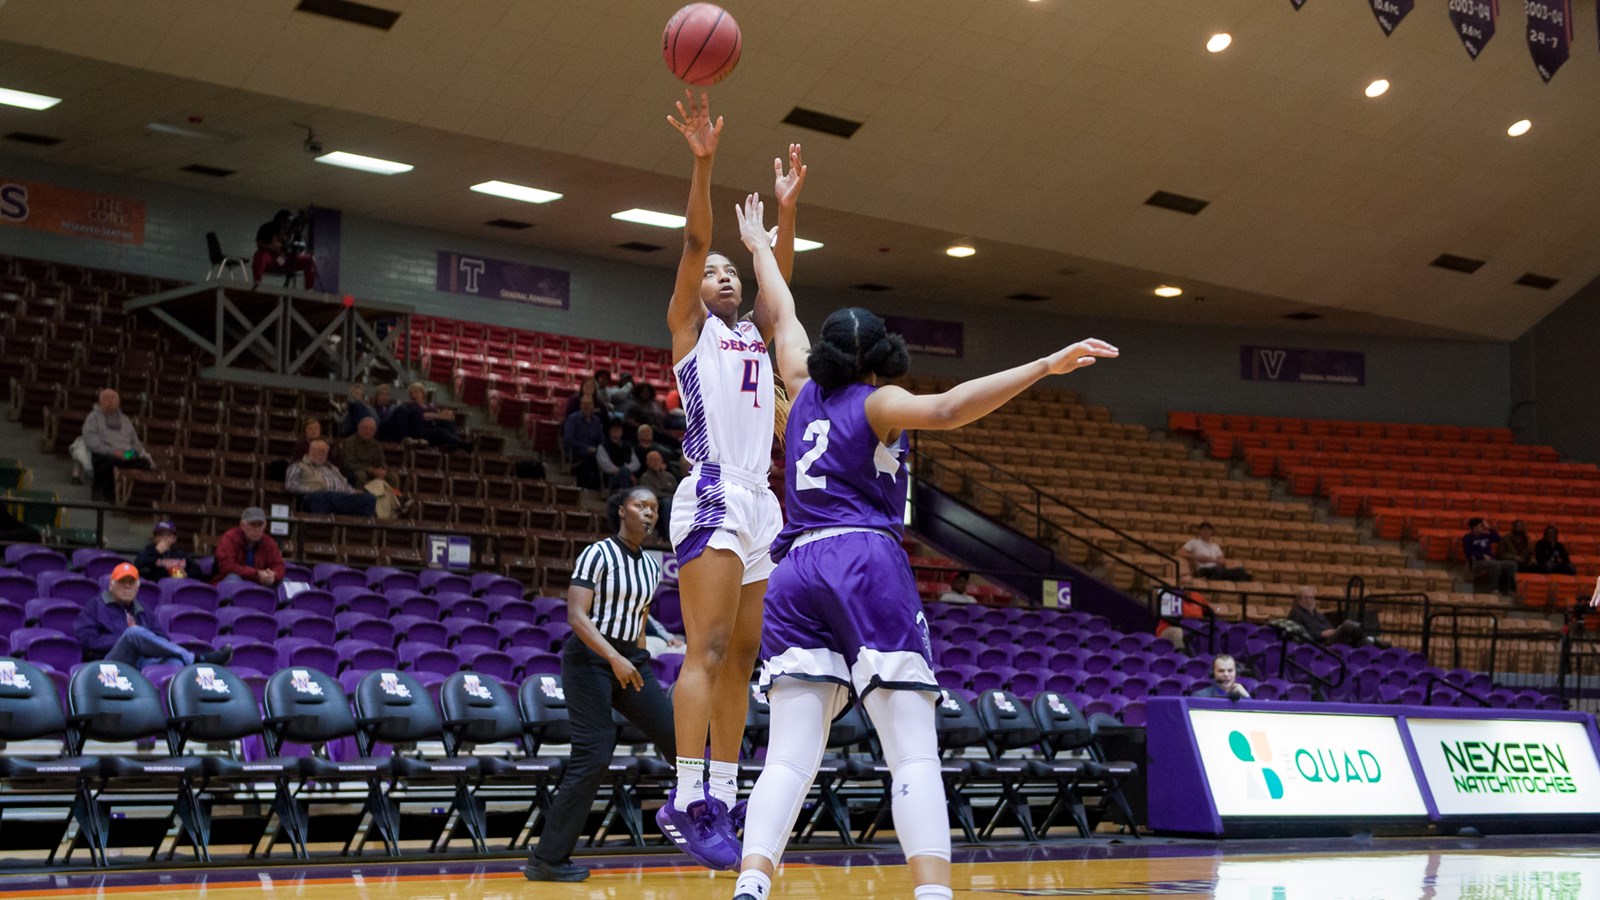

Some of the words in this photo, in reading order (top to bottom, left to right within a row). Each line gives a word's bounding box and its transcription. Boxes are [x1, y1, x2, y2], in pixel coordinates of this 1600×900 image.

[1449, 0, 1490, 21] 2003-04
[1523, 0, 1563, 26] 2003-04
[1530, 29, 1558, 48] 24-7
[0, 183, 29, 222] S
[460, 257, 486, 293] T
[1260, 349, 1286, 379] V
[740, 359, 761, 408] 4
[796, 419, 830, 490] 2
[431, 540, 447, 563] F
[1058, 586, 1071, 605] G
[1295, 748, 1381, 783] QUAD
[1440, 740, 1569, 773] NEXGEN
[1453, 775, 1577, 793] NATCHITOCHES
